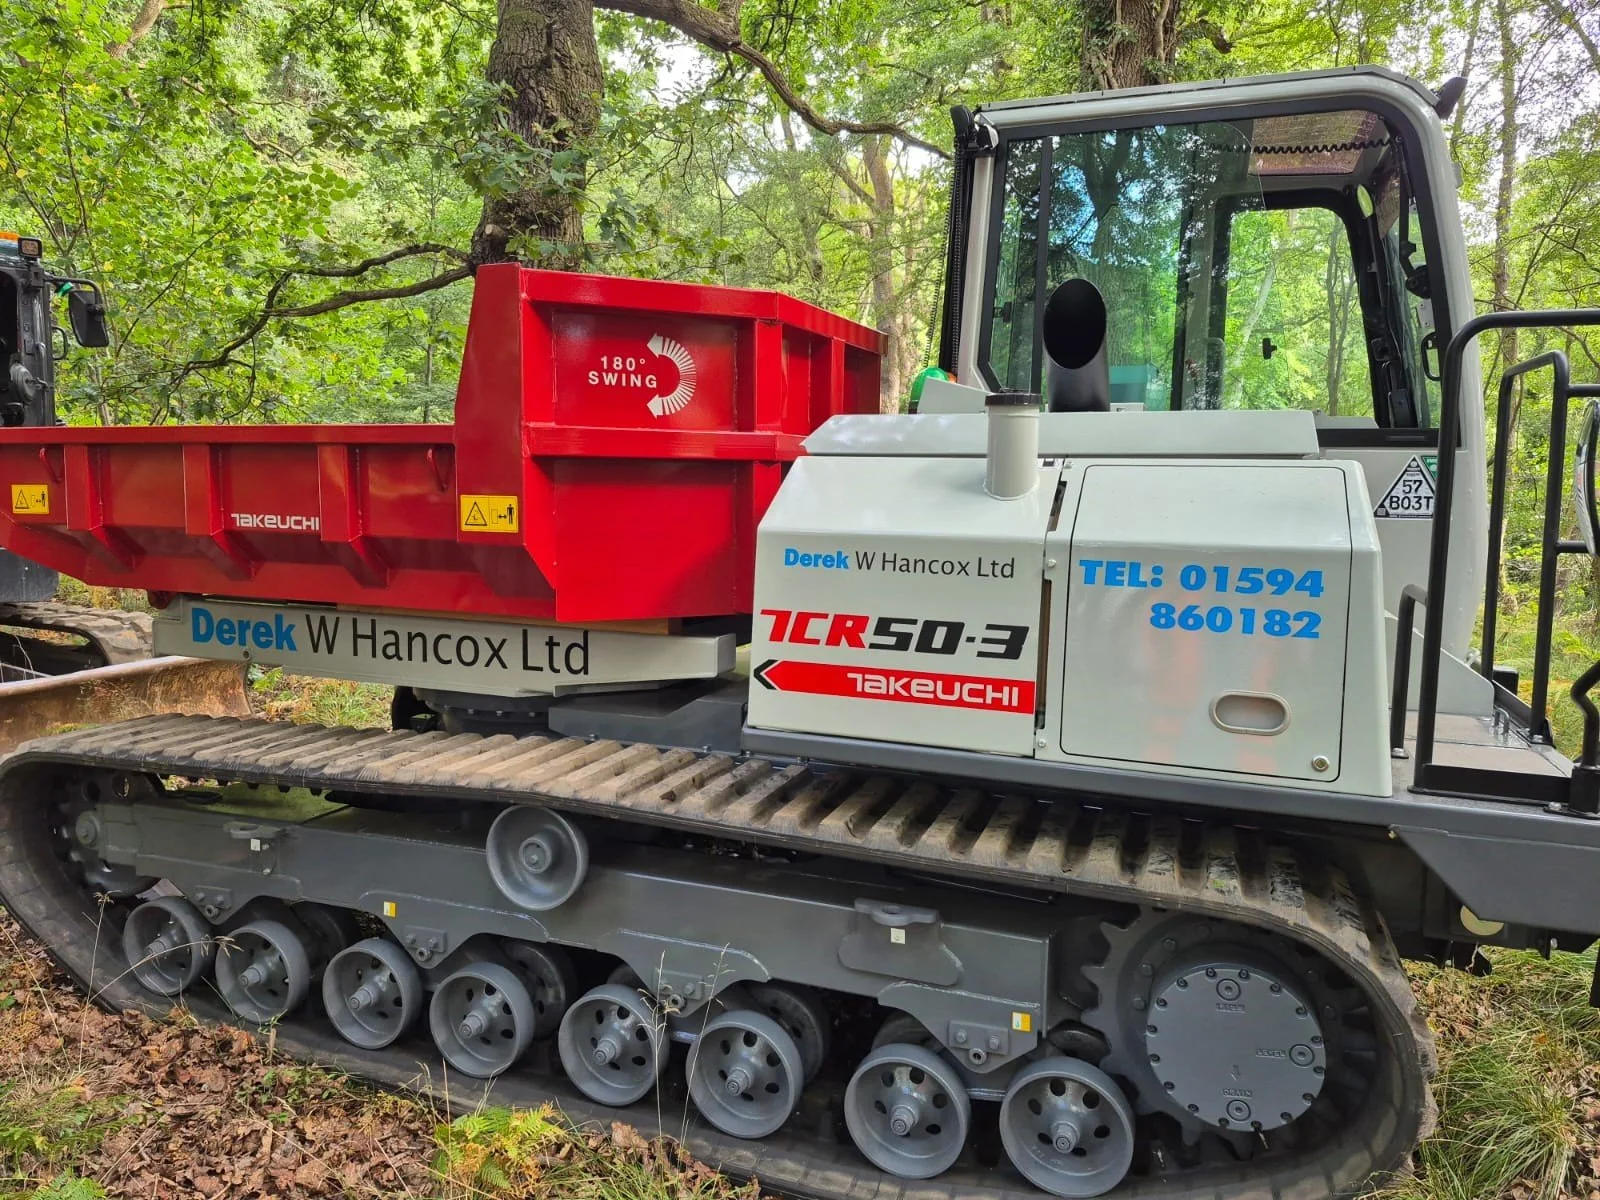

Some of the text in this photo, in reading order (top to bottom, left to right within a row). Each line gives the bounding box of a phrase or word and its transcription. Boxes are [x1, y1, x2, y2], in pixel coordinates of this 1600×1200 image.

[600, 356, 646, 371] 180°
[588, 371, 657, 388] SWING
[1402, 479, 1424, 495] 57
[784, 548, 1015, 579] Derek W Hancox Ltd
[1079, 559, 1325, 598] TEL: 01594
[1149, 602, 1322, 639] 860182
[191, 606, 590, 676] Derek W Hancox Ltd
